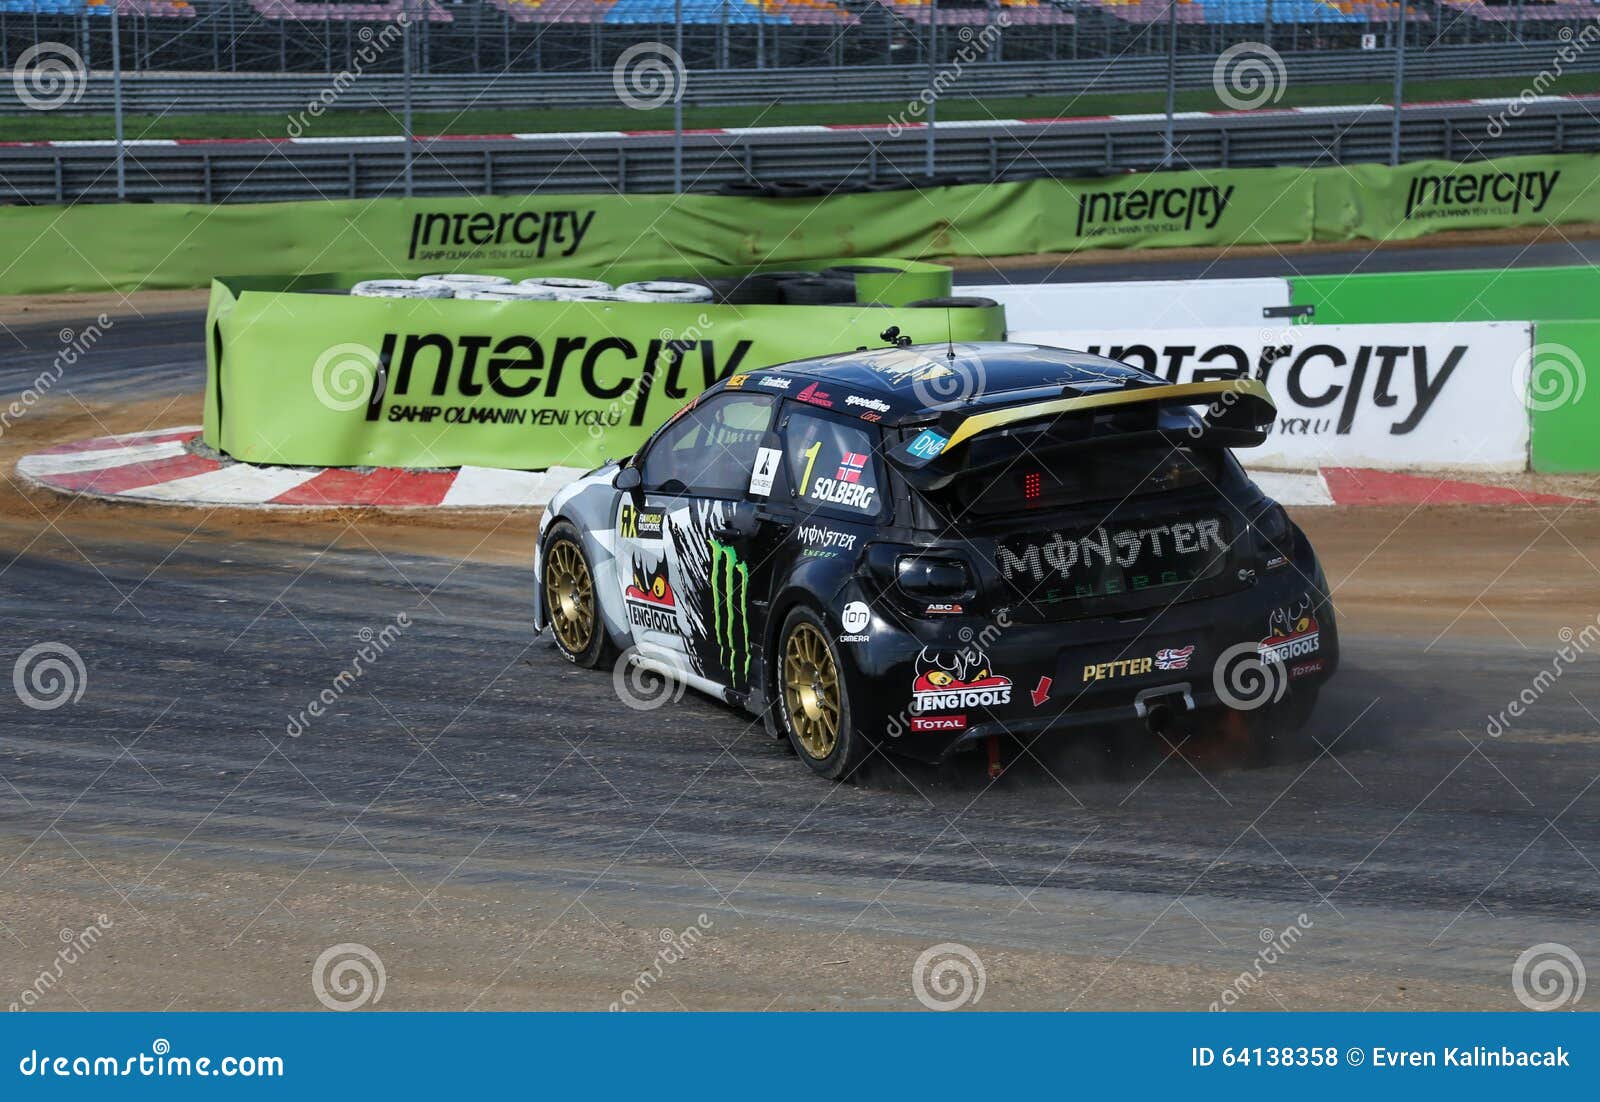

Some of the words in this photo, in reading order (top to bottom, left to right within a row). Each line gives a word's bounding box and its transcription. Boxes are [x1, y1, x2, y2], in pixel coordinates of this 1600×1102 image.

[444, 406, 527, 424] OLMANIN
[914, 434, 946, 457] DNB
[799, 441, 823, 496] 1
[812, 477, 875, 509] SOLBERG
[840, 635, 870, 643] CAMERA
[1082, 656, 1152, 682] PETTER
[914, 719, 965, 729] TOTAL
